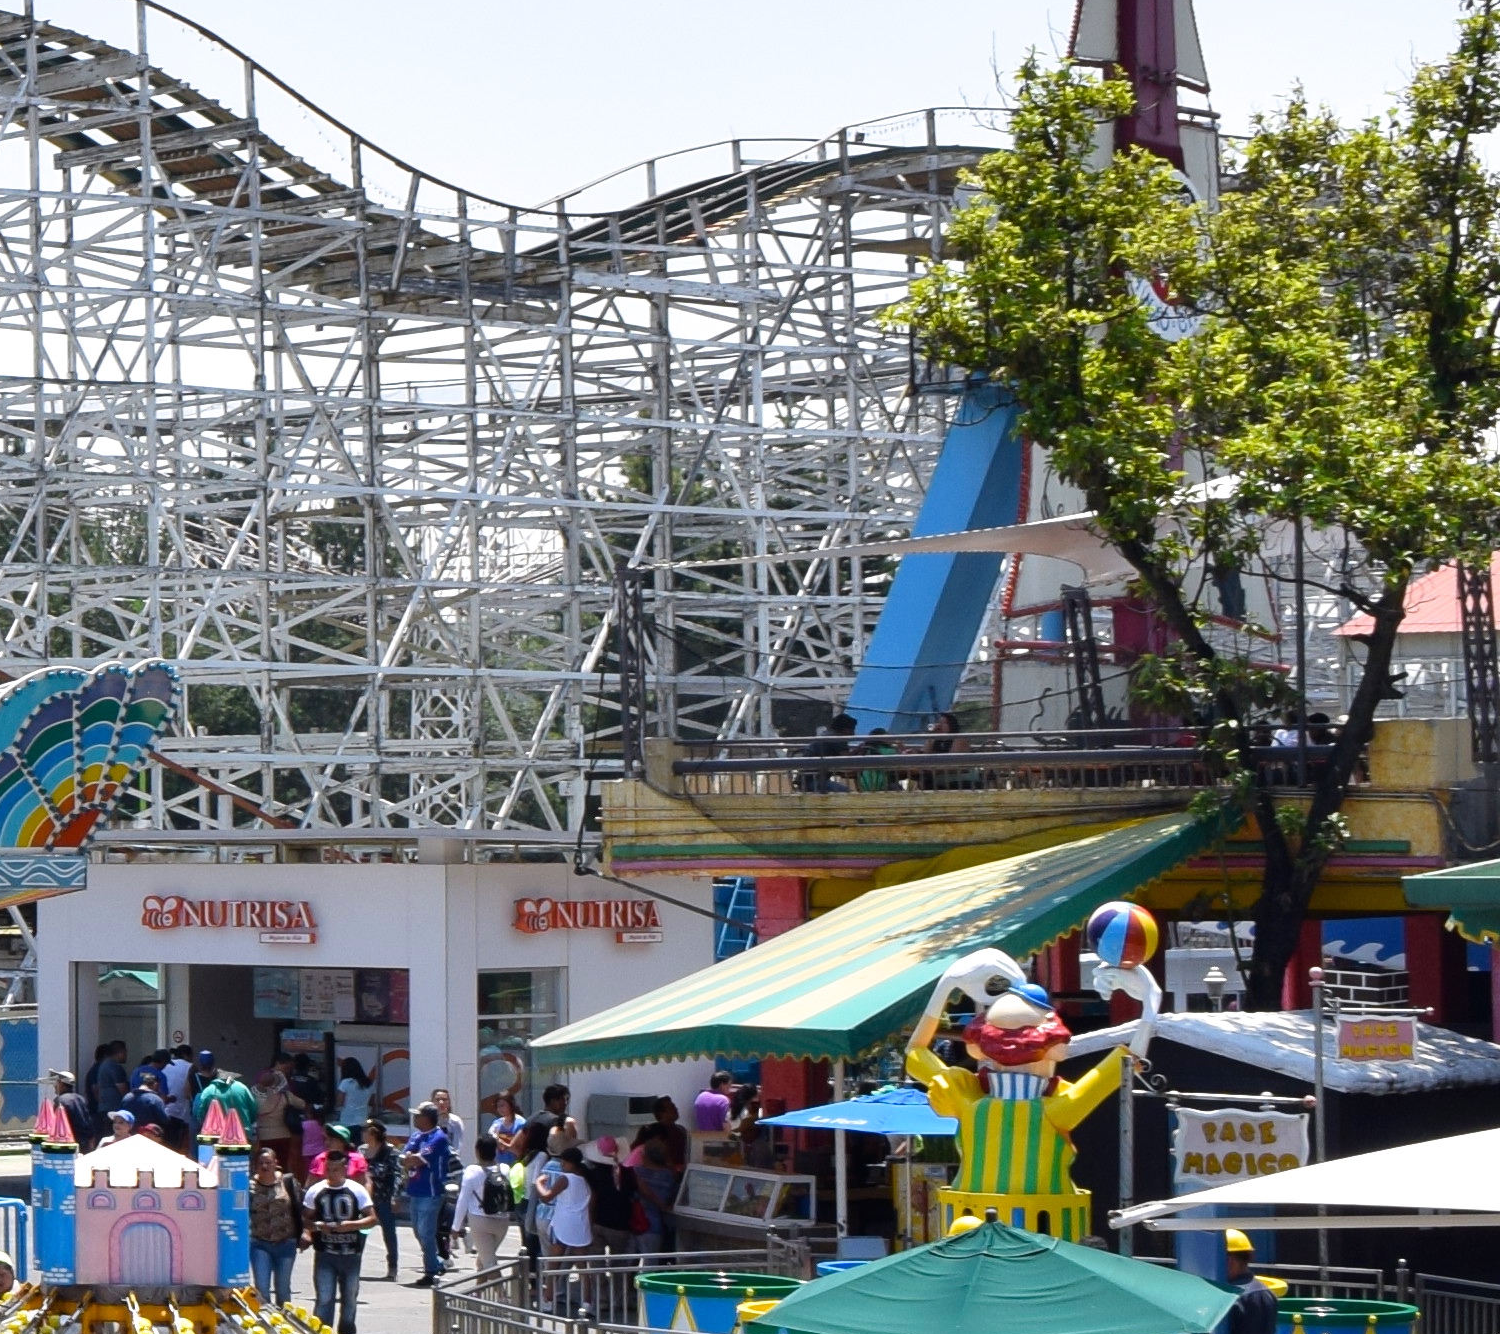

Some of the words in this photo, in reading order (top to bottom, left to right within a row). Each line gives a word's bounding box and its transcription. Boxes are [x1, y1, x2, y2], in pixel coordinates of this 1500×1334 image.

[181, 899, 318, 929] NUTRISA
[553, 899, 664, 929] NUTRISA
[1202, 1121, 1277, 1145] PASE
[1183, 1151, 1300, 1175] MAGICO
[321, 1193, 354, 1221] 10
